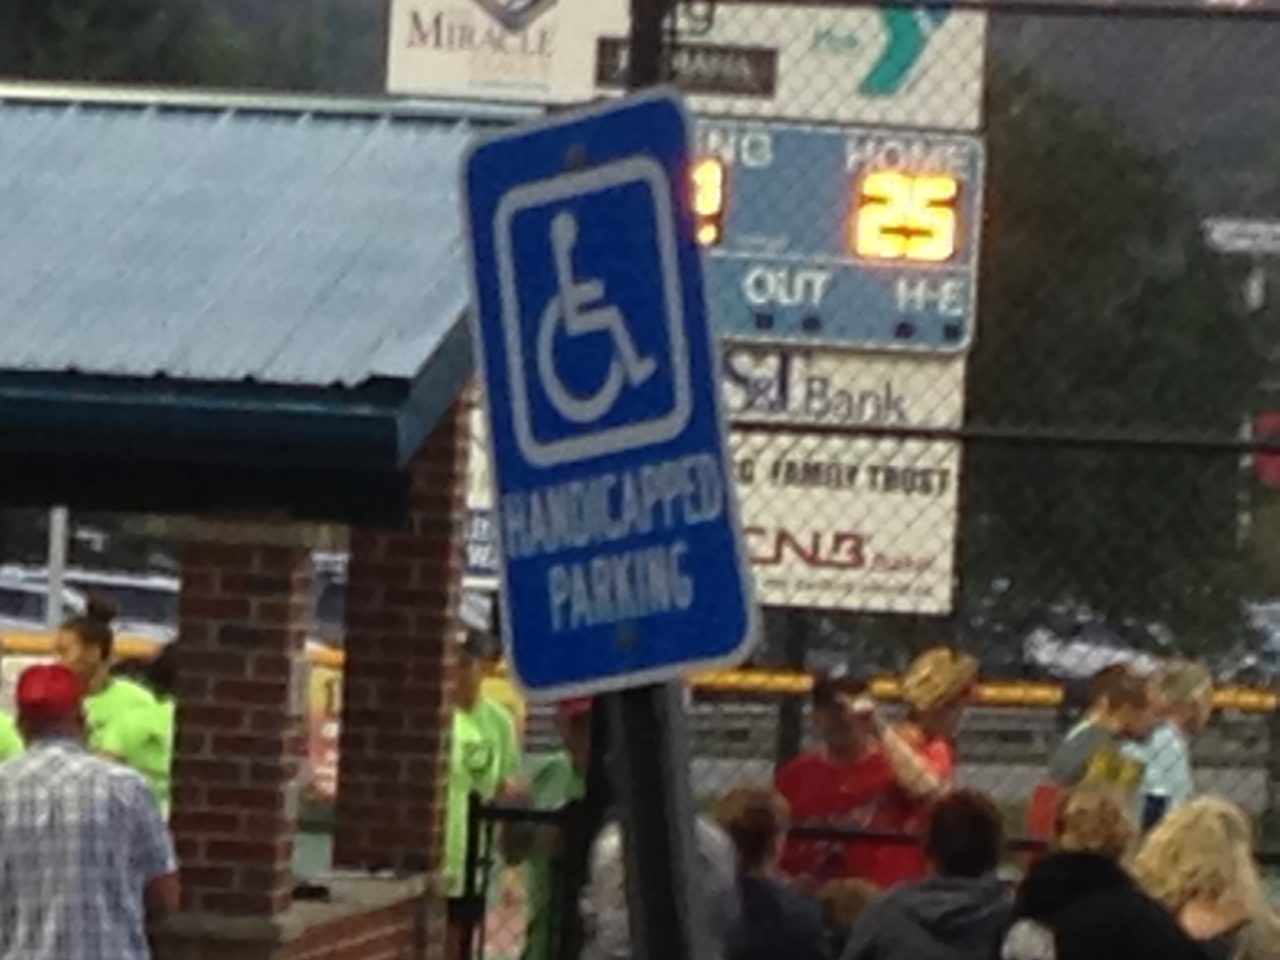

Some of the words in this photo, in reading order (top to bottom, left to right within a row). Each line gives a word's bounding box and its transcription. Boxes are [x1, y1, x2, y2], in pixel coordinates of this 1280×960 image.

[857, 170, 958, 261] 25
[744, 268, 830, 306] OUT
[805, 377, 908, 421] Bank
[504, 453, 721, 559] HANDICAPPED
[866, 466, 951, 495] TRUST
[548, 540, 696, 633] PARKING
